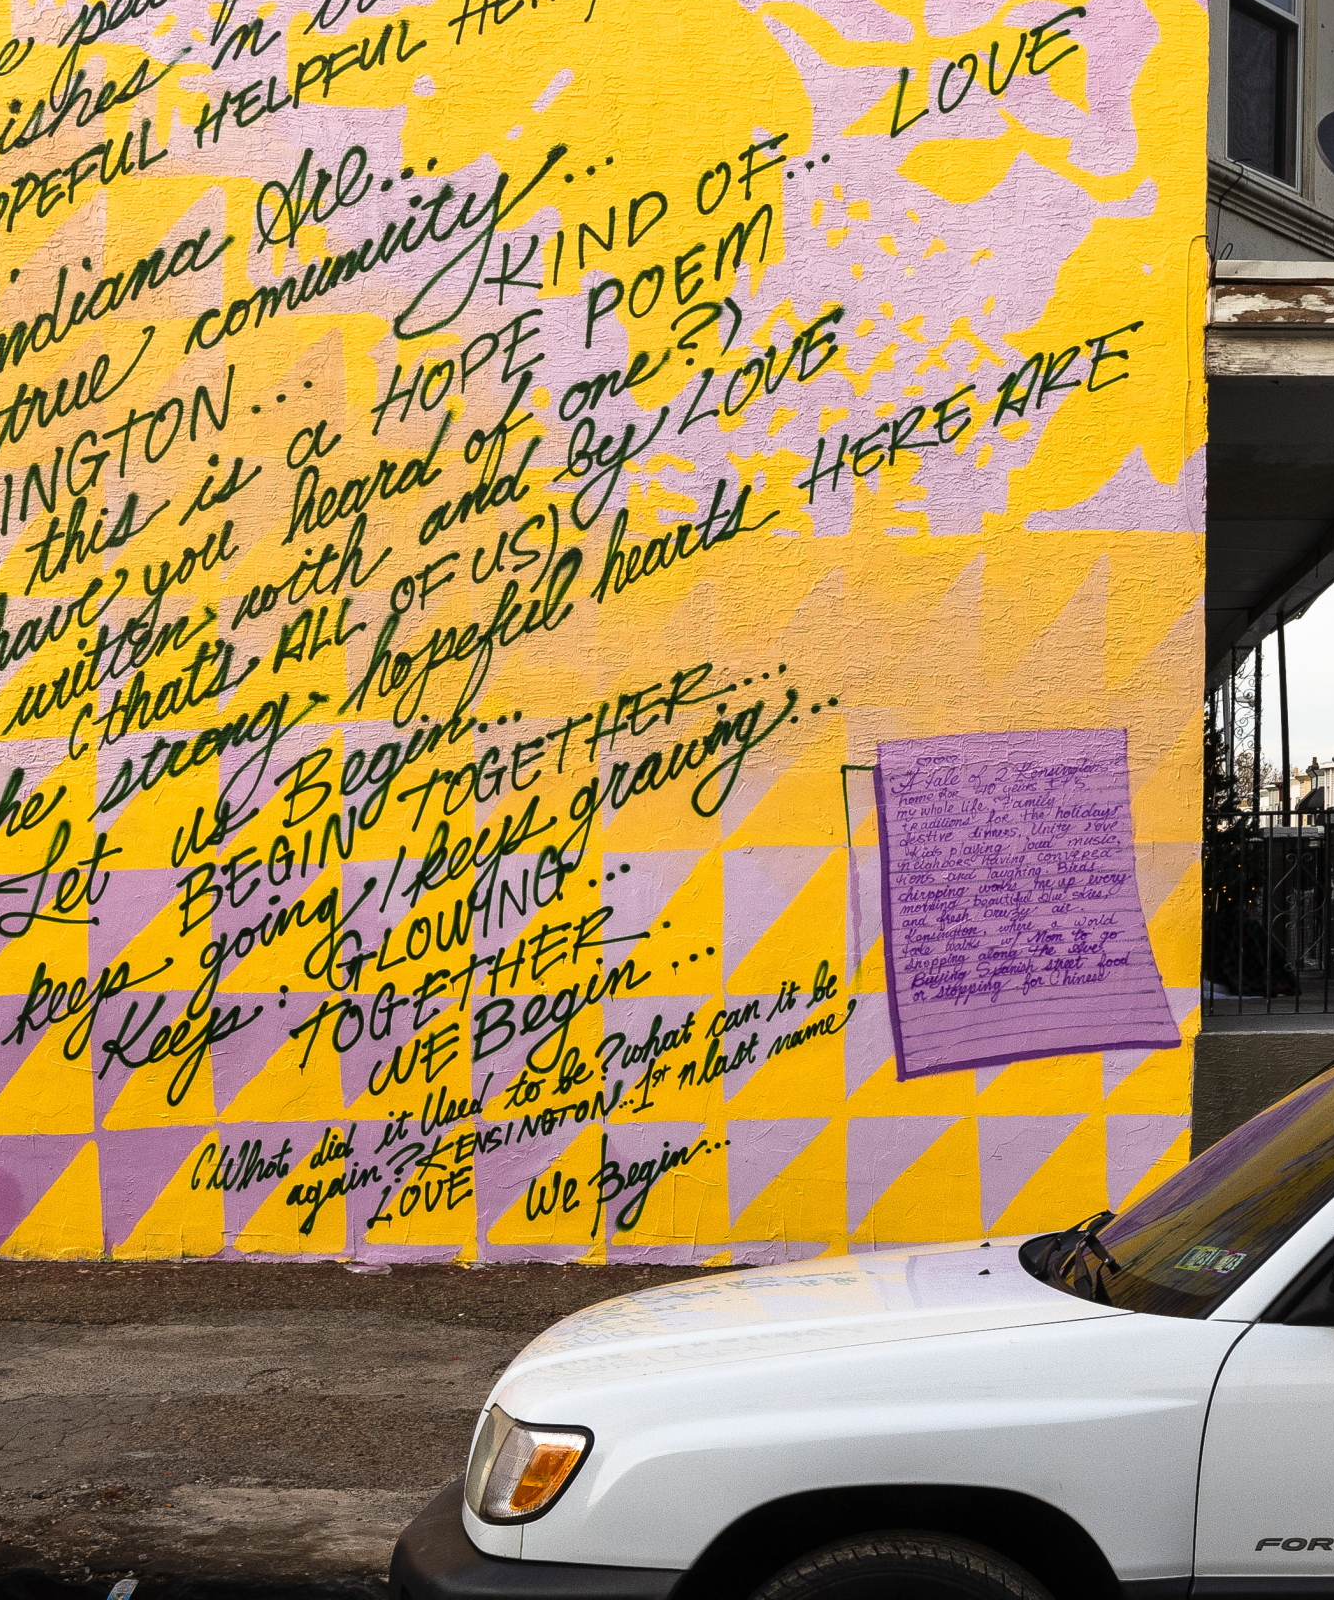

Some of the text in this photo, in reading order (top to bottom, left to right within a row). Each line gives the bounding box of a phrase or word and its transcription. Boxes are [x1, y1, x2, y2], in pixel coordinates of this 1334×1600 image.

[193, 20, 427, 150] HELPFUL
[484, 189, 669, 306] KIND
[891, 6, 1087, 139] LOVE
[25, 202, 774, 595] this is a HOPE POEM
[1, 304, 845, 736] written with and by LOVE
[142, 520, 240, 646] you
[283, 409, 455, 546] heard
[464, 371, 534, 490] of
[338, 545, 585, 730] hopeful
[591, 478, 780, 603] hearts
[798, 383, 976, 506] HERE
[993, 320, 1145, 427] ARE
[272, 596, 367, 675] ALL
[390, 551, 464, 615] OF
[472, 502, 561, 592] US)
[921, 800, 955, 817] whole
[968, 765, 987, 791] of
[994, 766, 1009, 783] 2
[975, 782, 997, 796] 40
[170, 797, 261, 867] us
[1020, 808, 1045, 821] the
[1031, 821, 1076, 839] Unity
[175, 805, 357, 938] BEGIN
[950, 842, 1010, 863] playing
[1058, 861, 1096, 874] Birds
[1087, 873, 1133, 895] every
[186, 874, 379, 1021] going
[976, 958, 1038, 983] Spanish
[1042, 955, 1089, 971] street
[1097, 951, 1131, 976] food
[1027, 928, 1126, 945] Mom to go
[931, 969, 1111, 1006] stopping for Chinese
[309, 1122, 357, 1171] did
[374, 1110, 414, 1155] it
[420, 1071, 495, 1136] Used
[503, 1067, 547, 1110] to
[552, 1031, 627, 1096] be?
[621, 1014, 697, 1070] what
[704, 999, 761, 1040] can
[766, 980, 802, 1023] it
[805, 959, 838, 1009] be
[367, 1022, 462, 1096] WE
[696, 1037, 761, 1087] last
[366, 1165, 474, 1230] LOVE
[525, 1170, 581, 1222] We
